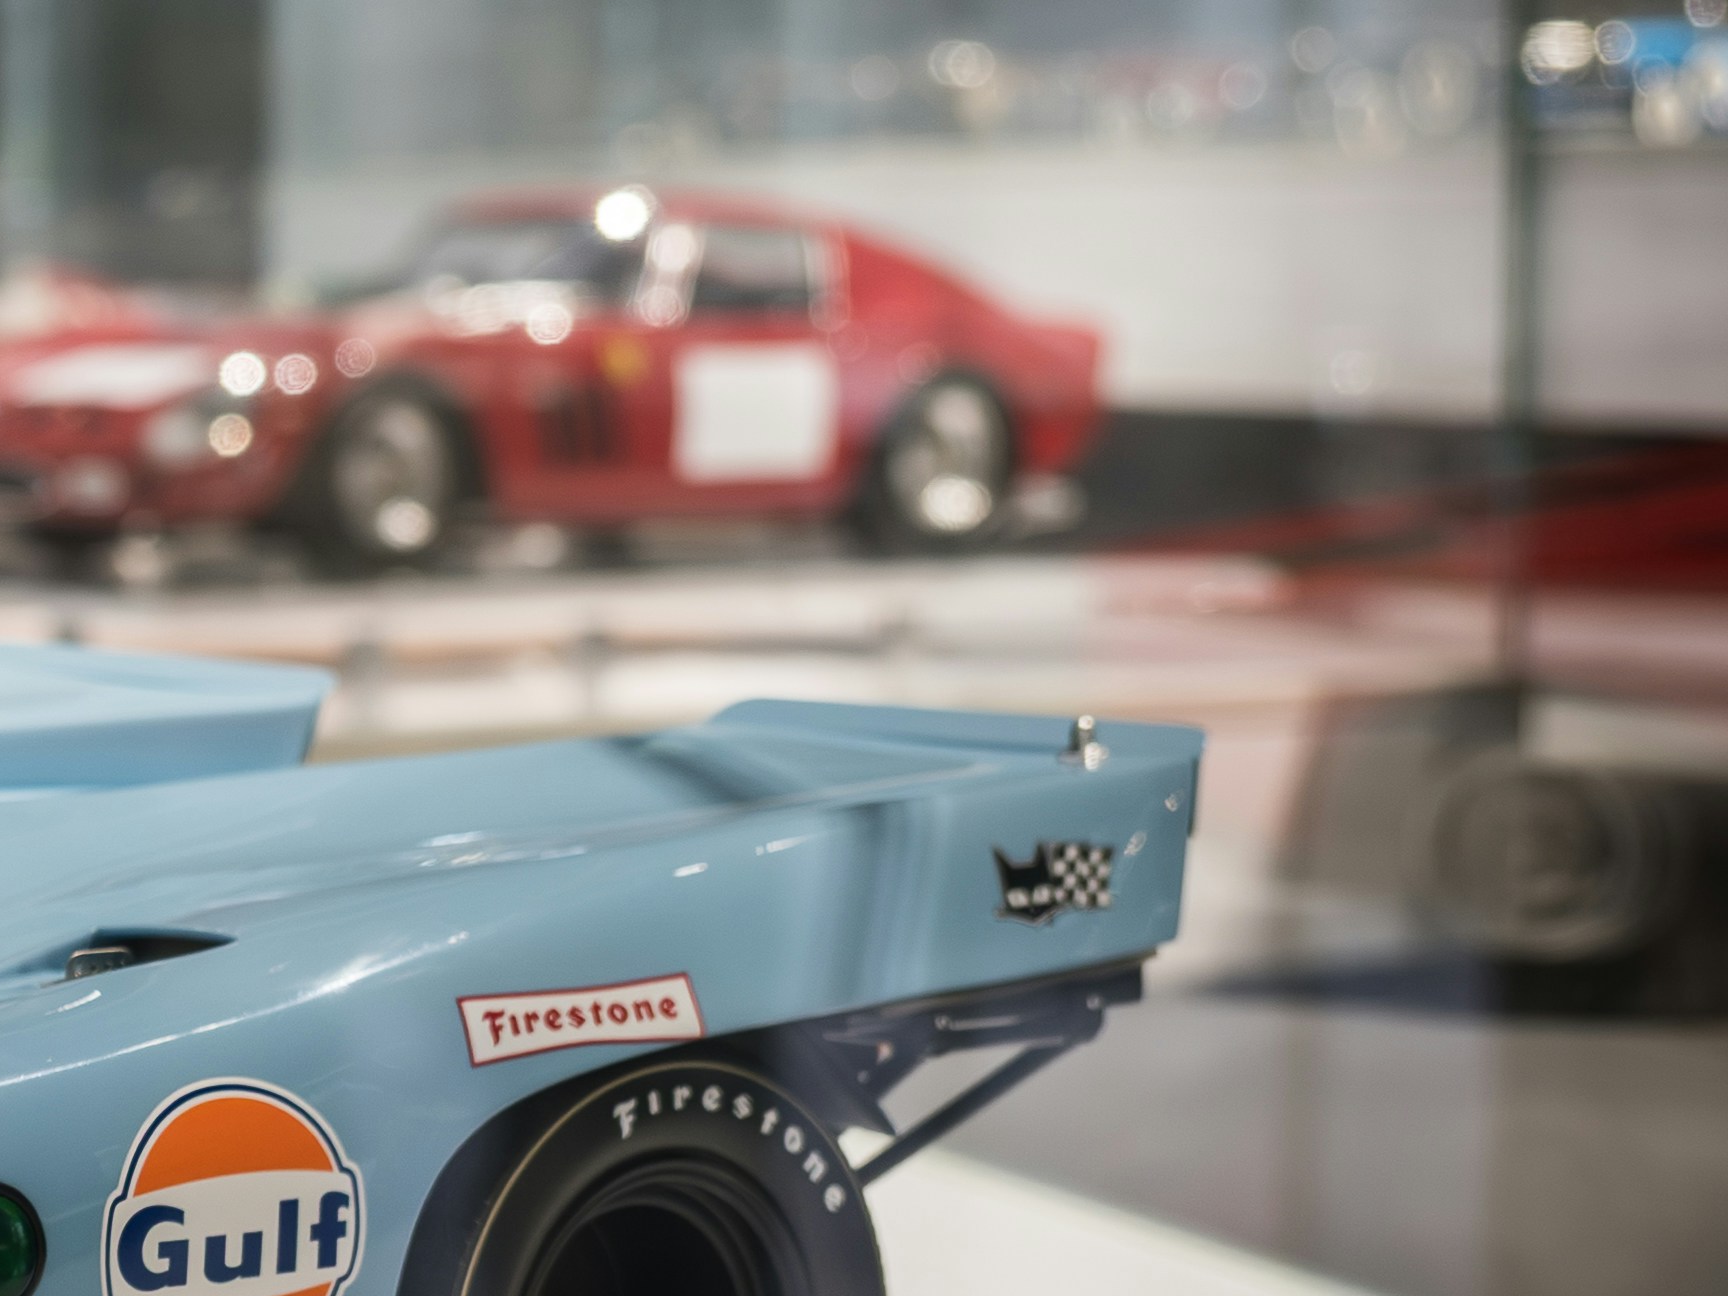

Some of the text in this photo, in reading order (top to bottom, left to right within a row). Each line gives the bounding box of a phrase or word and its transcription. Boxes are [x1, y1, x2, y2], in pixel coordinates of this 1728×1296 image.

[482, 995, 680, 1048] Firestone
[612, 1083, 848, 1215] Firestone
[116, 1190, 351, 1292] Gulf
